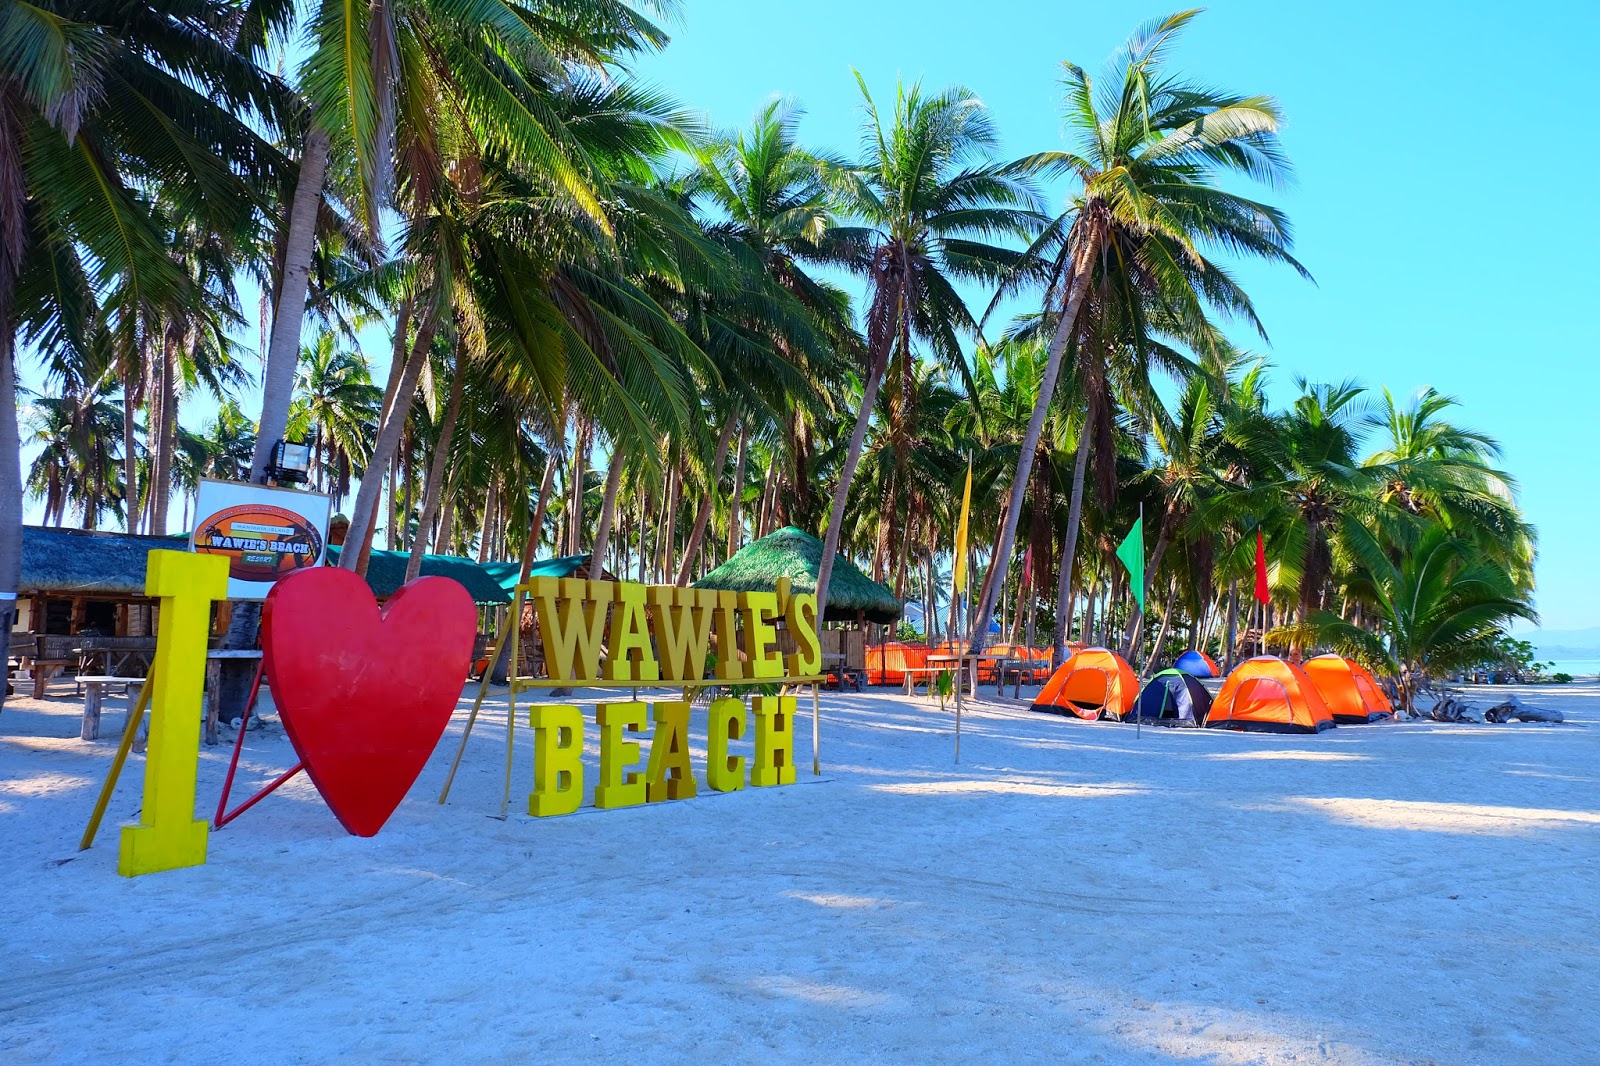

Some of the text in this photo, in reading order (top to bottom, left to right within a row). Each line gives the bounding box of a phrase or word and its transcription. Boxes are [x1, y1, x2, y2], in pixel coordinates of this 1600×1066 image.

[211, 536, 310, 554] WAWIE'S BEACH
[246, 555, 273, 563] RESORT
[529, 576, 822, 681] WAWIE'S
[118, 549, 230, 877] I
[528, 696, 798, 817] BEACH
